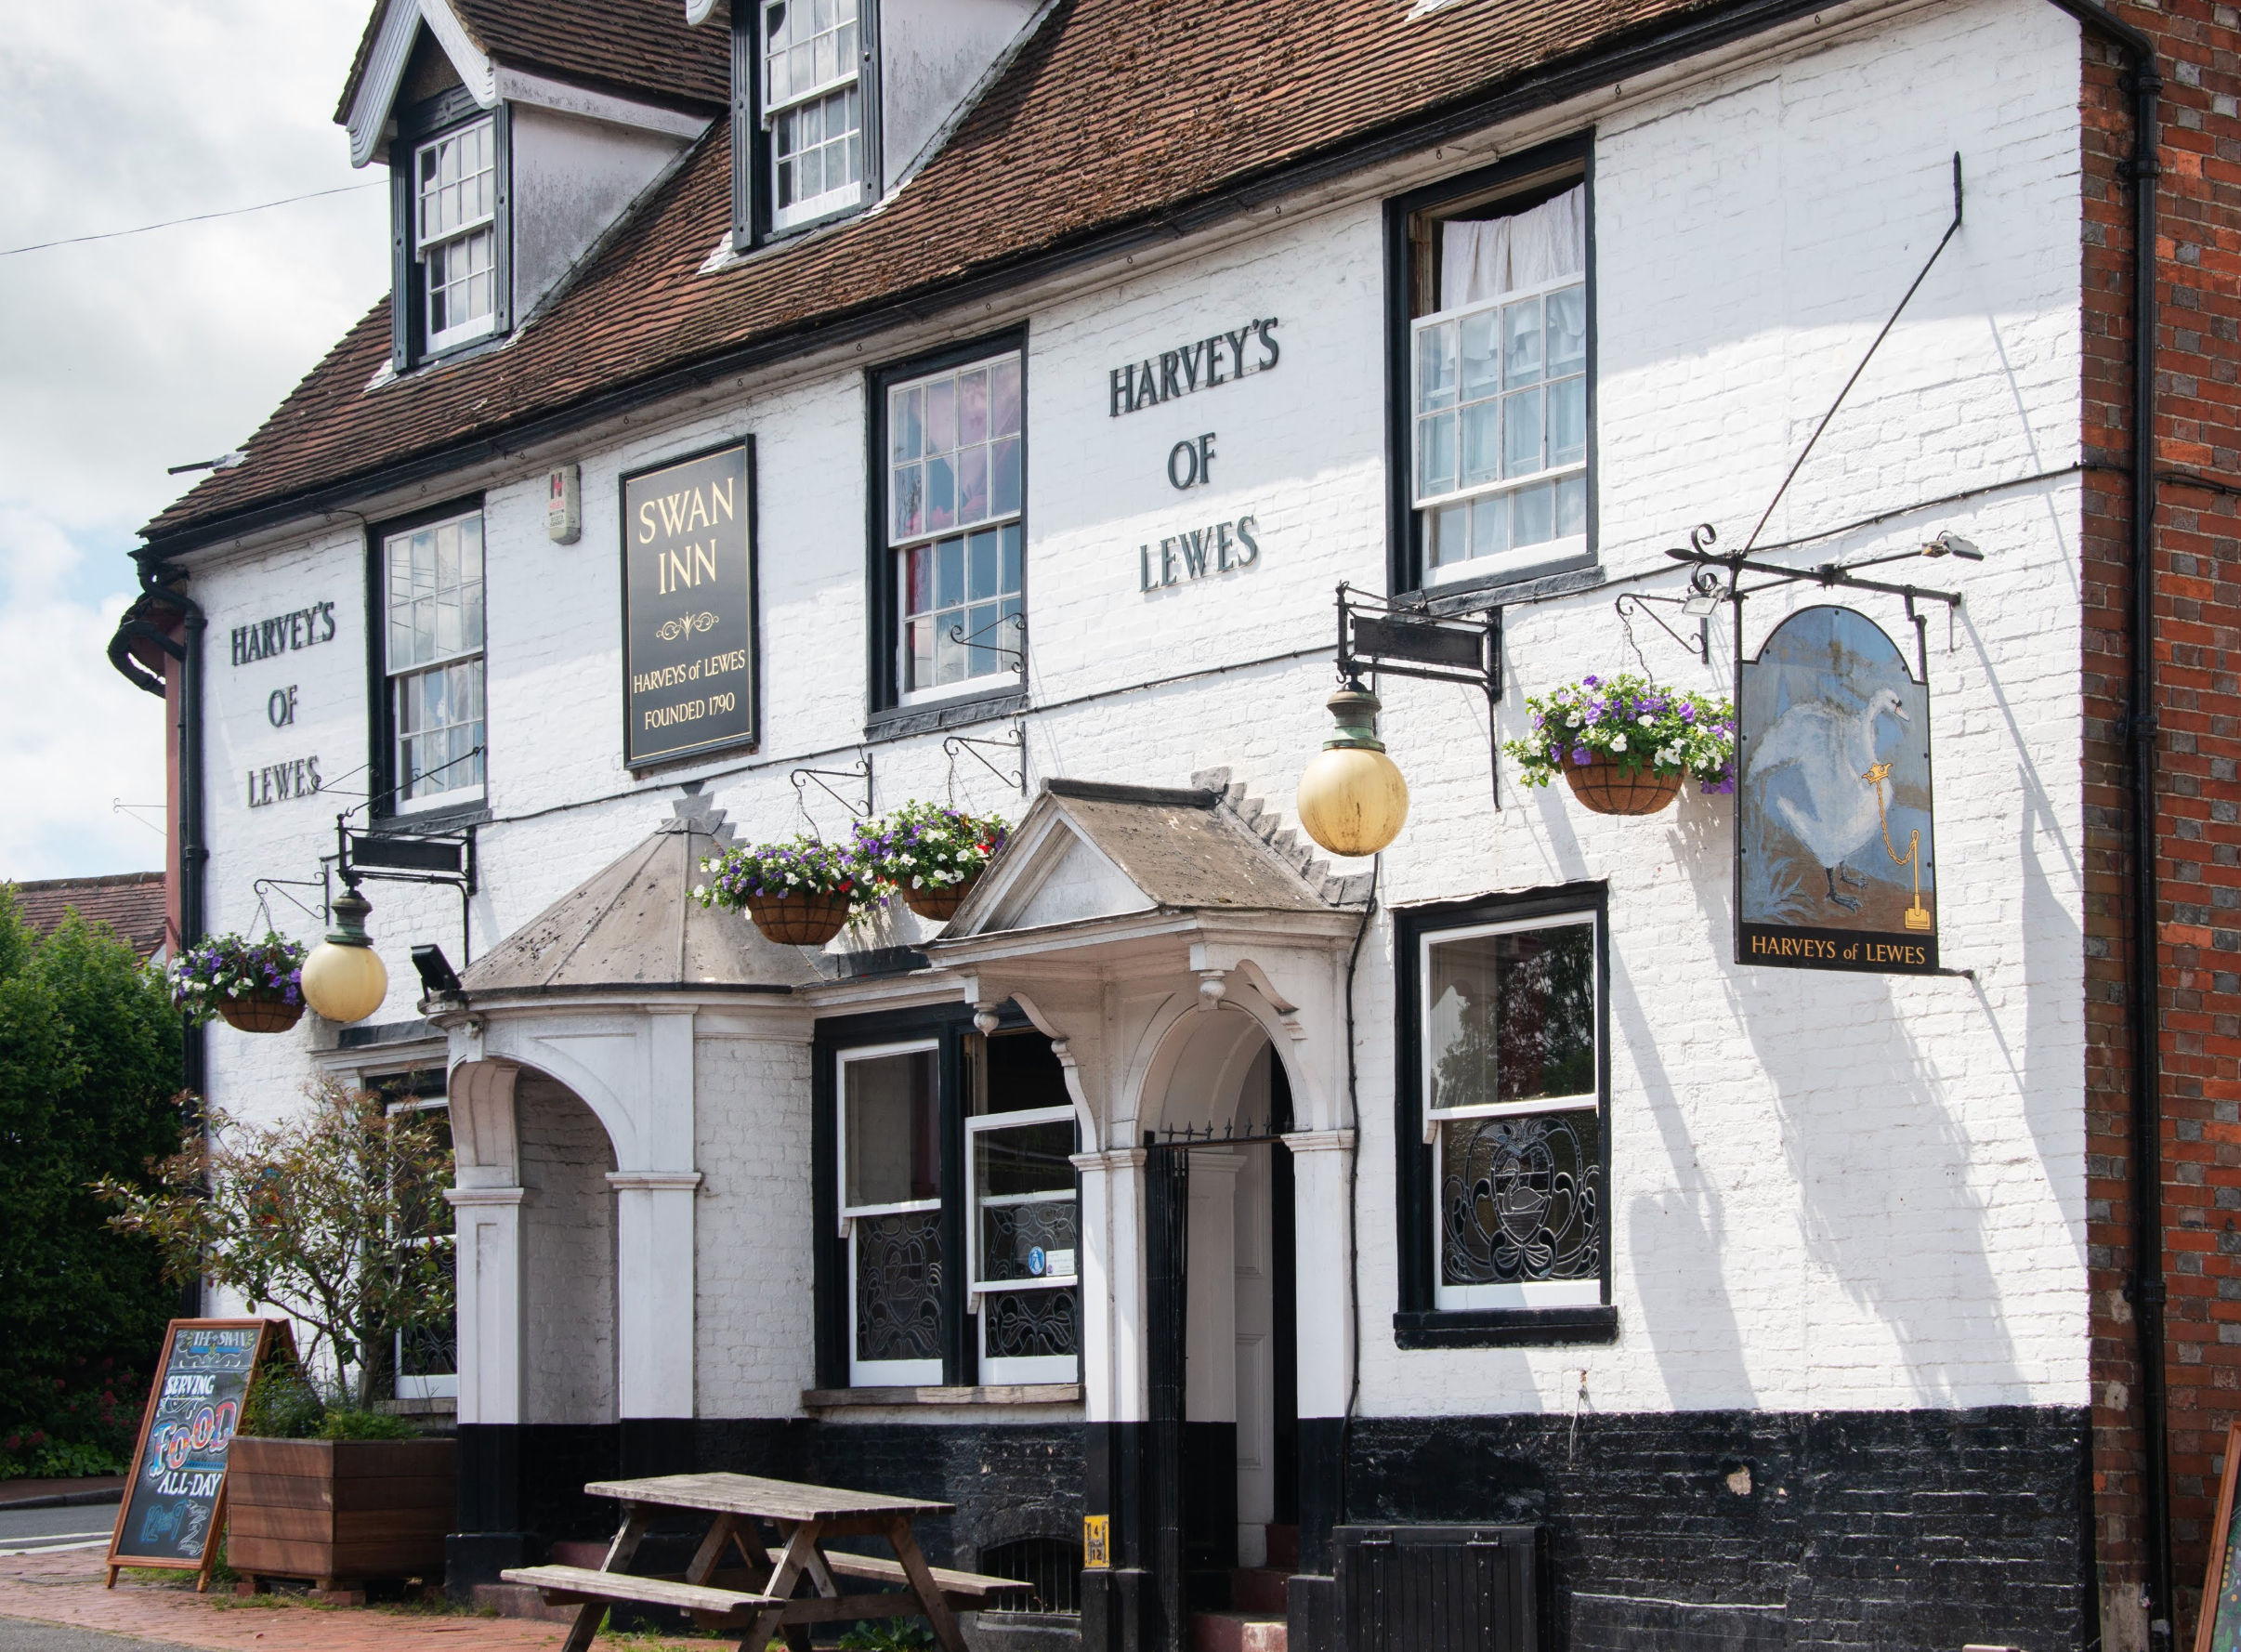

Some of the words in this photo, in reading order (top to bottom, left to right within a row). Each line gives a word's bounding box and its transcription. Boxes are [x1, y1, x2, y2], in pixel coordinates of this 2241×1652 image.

[1109, 317, 1279, 417] HARVEY'S
[1167, 432, 1215, 490] OF
[639, 478, 734, 544] SWAN
[659, 538, 716, 595] INN
[1139, 514, 1259, 593] LEWES
[230, 601, 335, 666] HARVEY'S
[634, 663, 687, 693] HARVEYS
[688, 660, 701, 680] of
[705, 649, 745, 676] LEWES
[268, 685, 297, 728] OF
[645, 700, 705, 730] FOUNDED
[709, 692, 735, 715] 1790
[247, 755, 319, 808] LEWES
[1751, 936, 1836, 959] HARVEYS
[1843, 942, 1859, 961] of
[1866, 943, 1926, 964] LEWES
[193, 1331, 214, 1346] THE
[217, 1331, 246, 1346] SWAN
[164, 1374, 216, 1396] SERVING
[149, 1400, 237, 1477] FOOD
